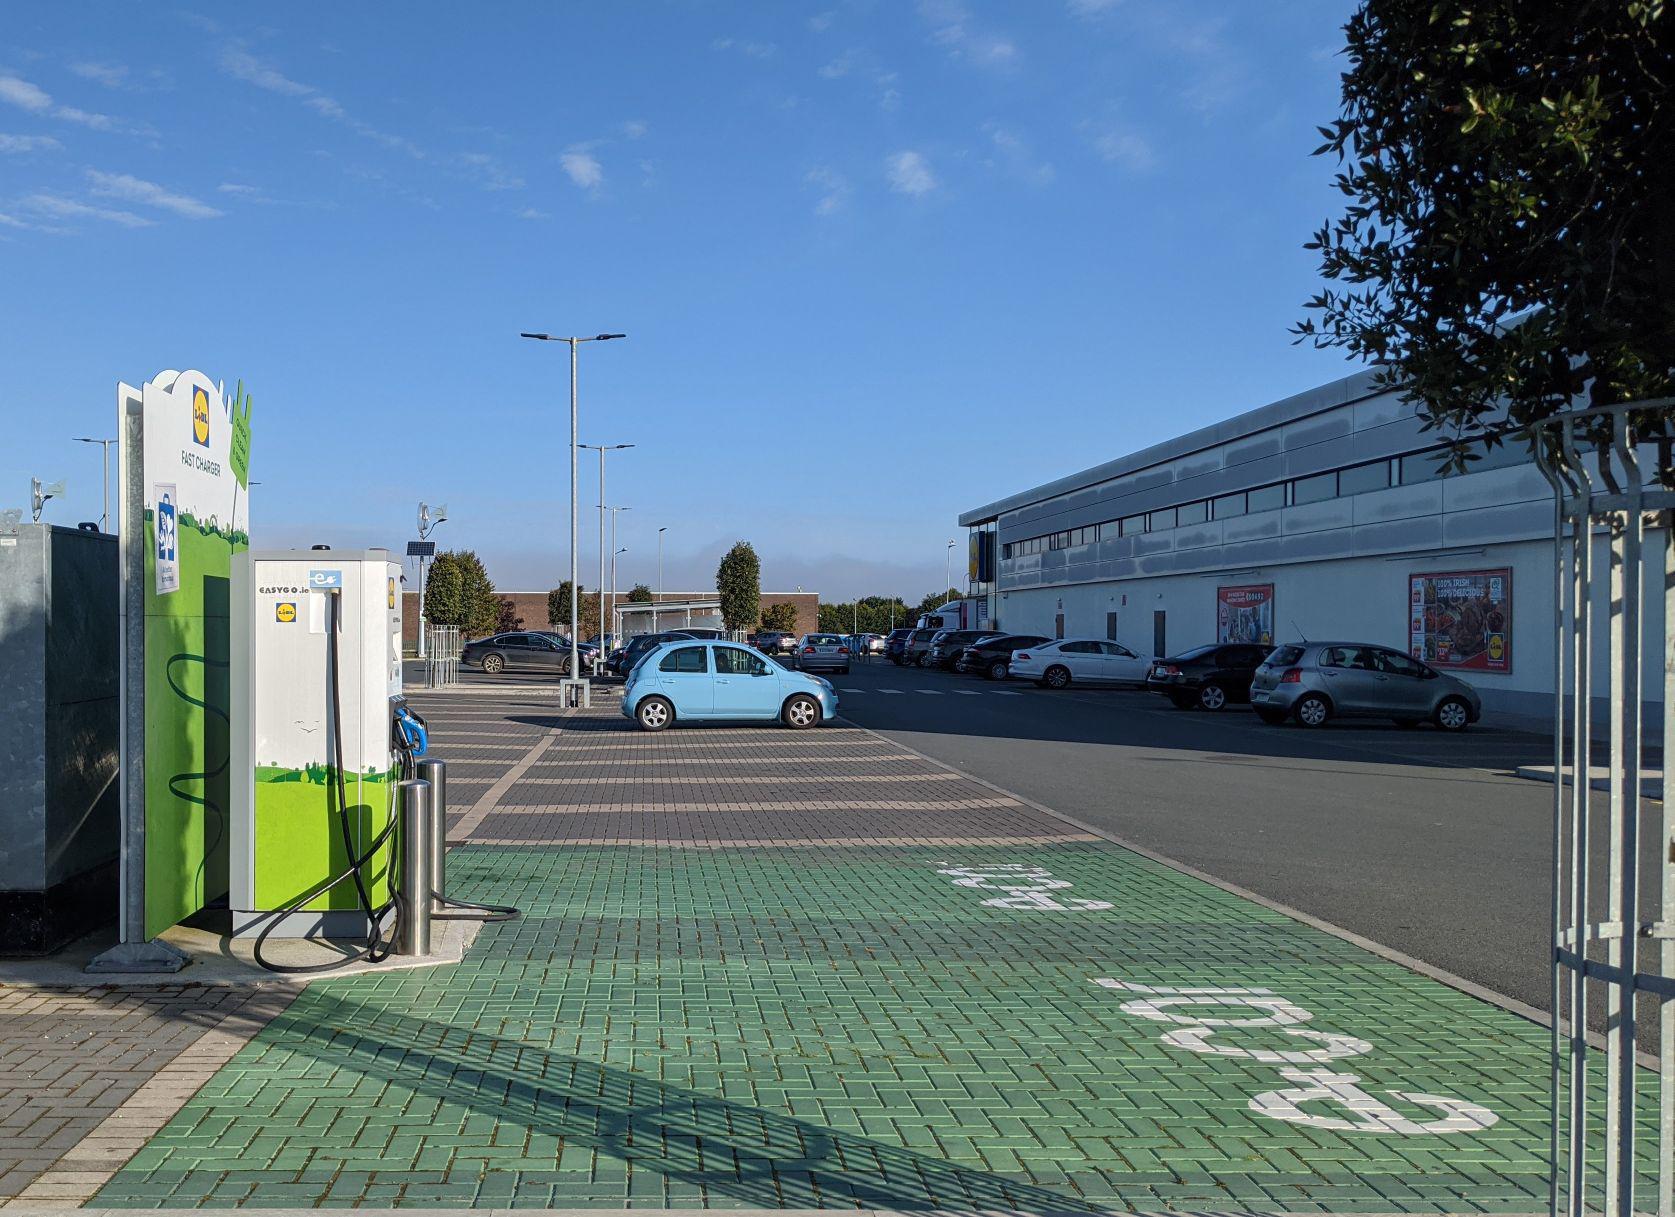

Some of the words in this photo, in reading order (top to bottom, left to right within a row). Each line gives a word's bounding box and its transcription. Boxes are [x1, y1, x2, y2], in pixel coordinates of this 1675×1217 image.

[181, 450, 195, 468] FAST
[196, 456, 221, 477] CHARGER
[1455, 578, 1470, 587] IRISH
